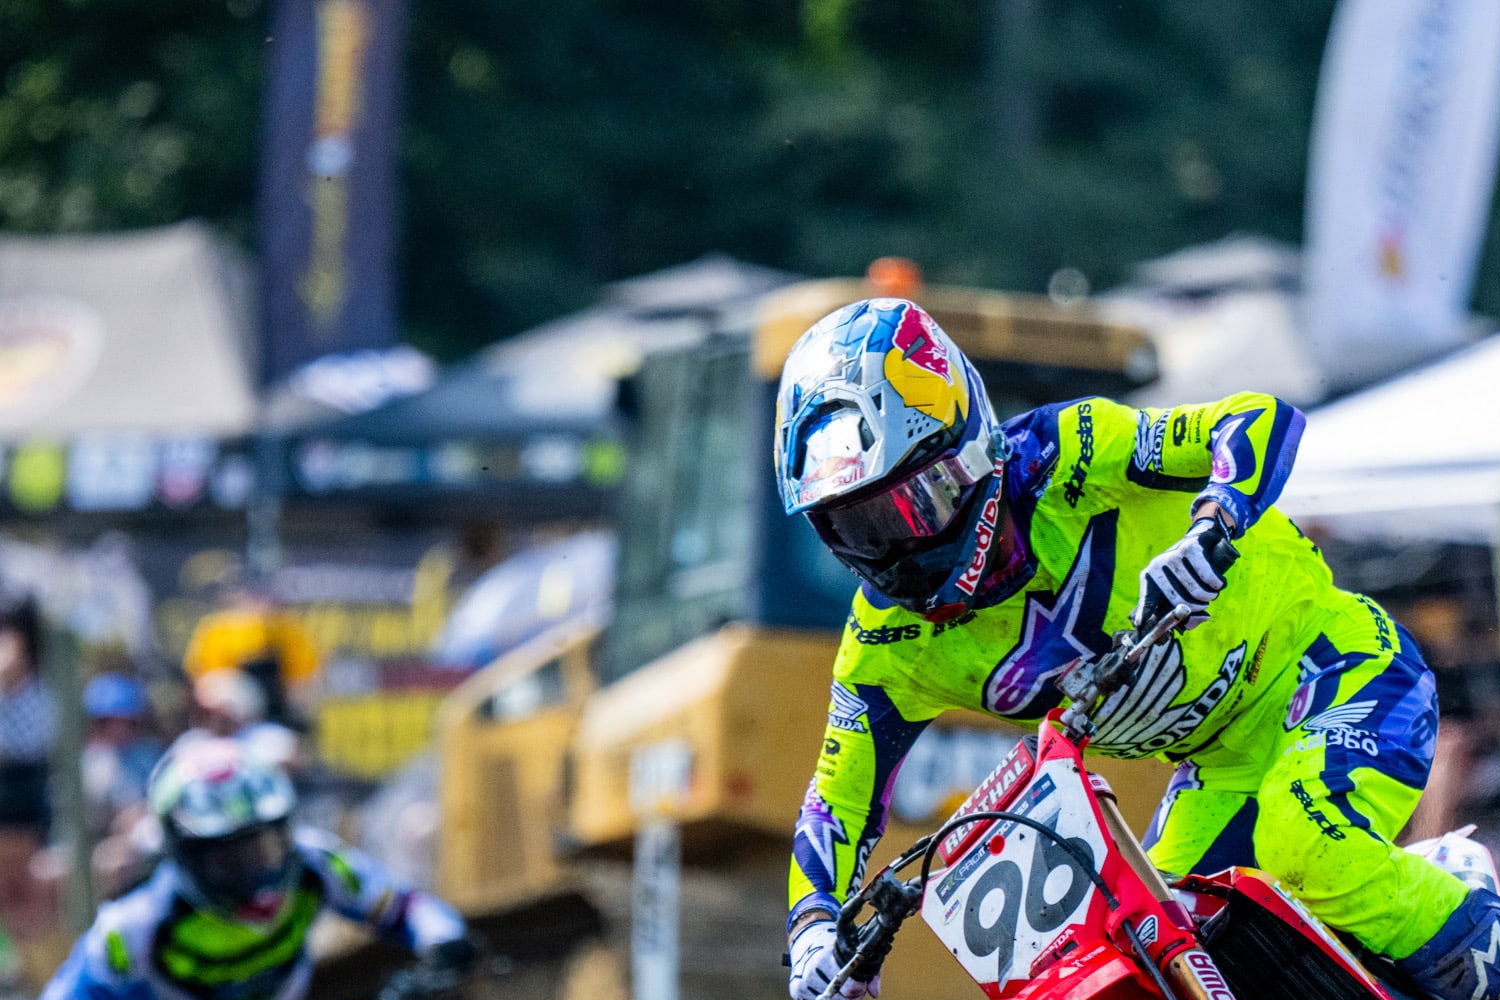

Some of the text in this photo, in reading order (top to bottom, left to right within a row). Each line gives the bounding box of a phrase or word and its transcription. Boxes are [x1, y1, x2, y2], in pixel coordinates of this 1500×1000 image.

[1150, 408, 1172, 474] HOND
[828, 715, 866, 733] NDA
[963, 807, 1095, 993] 96
